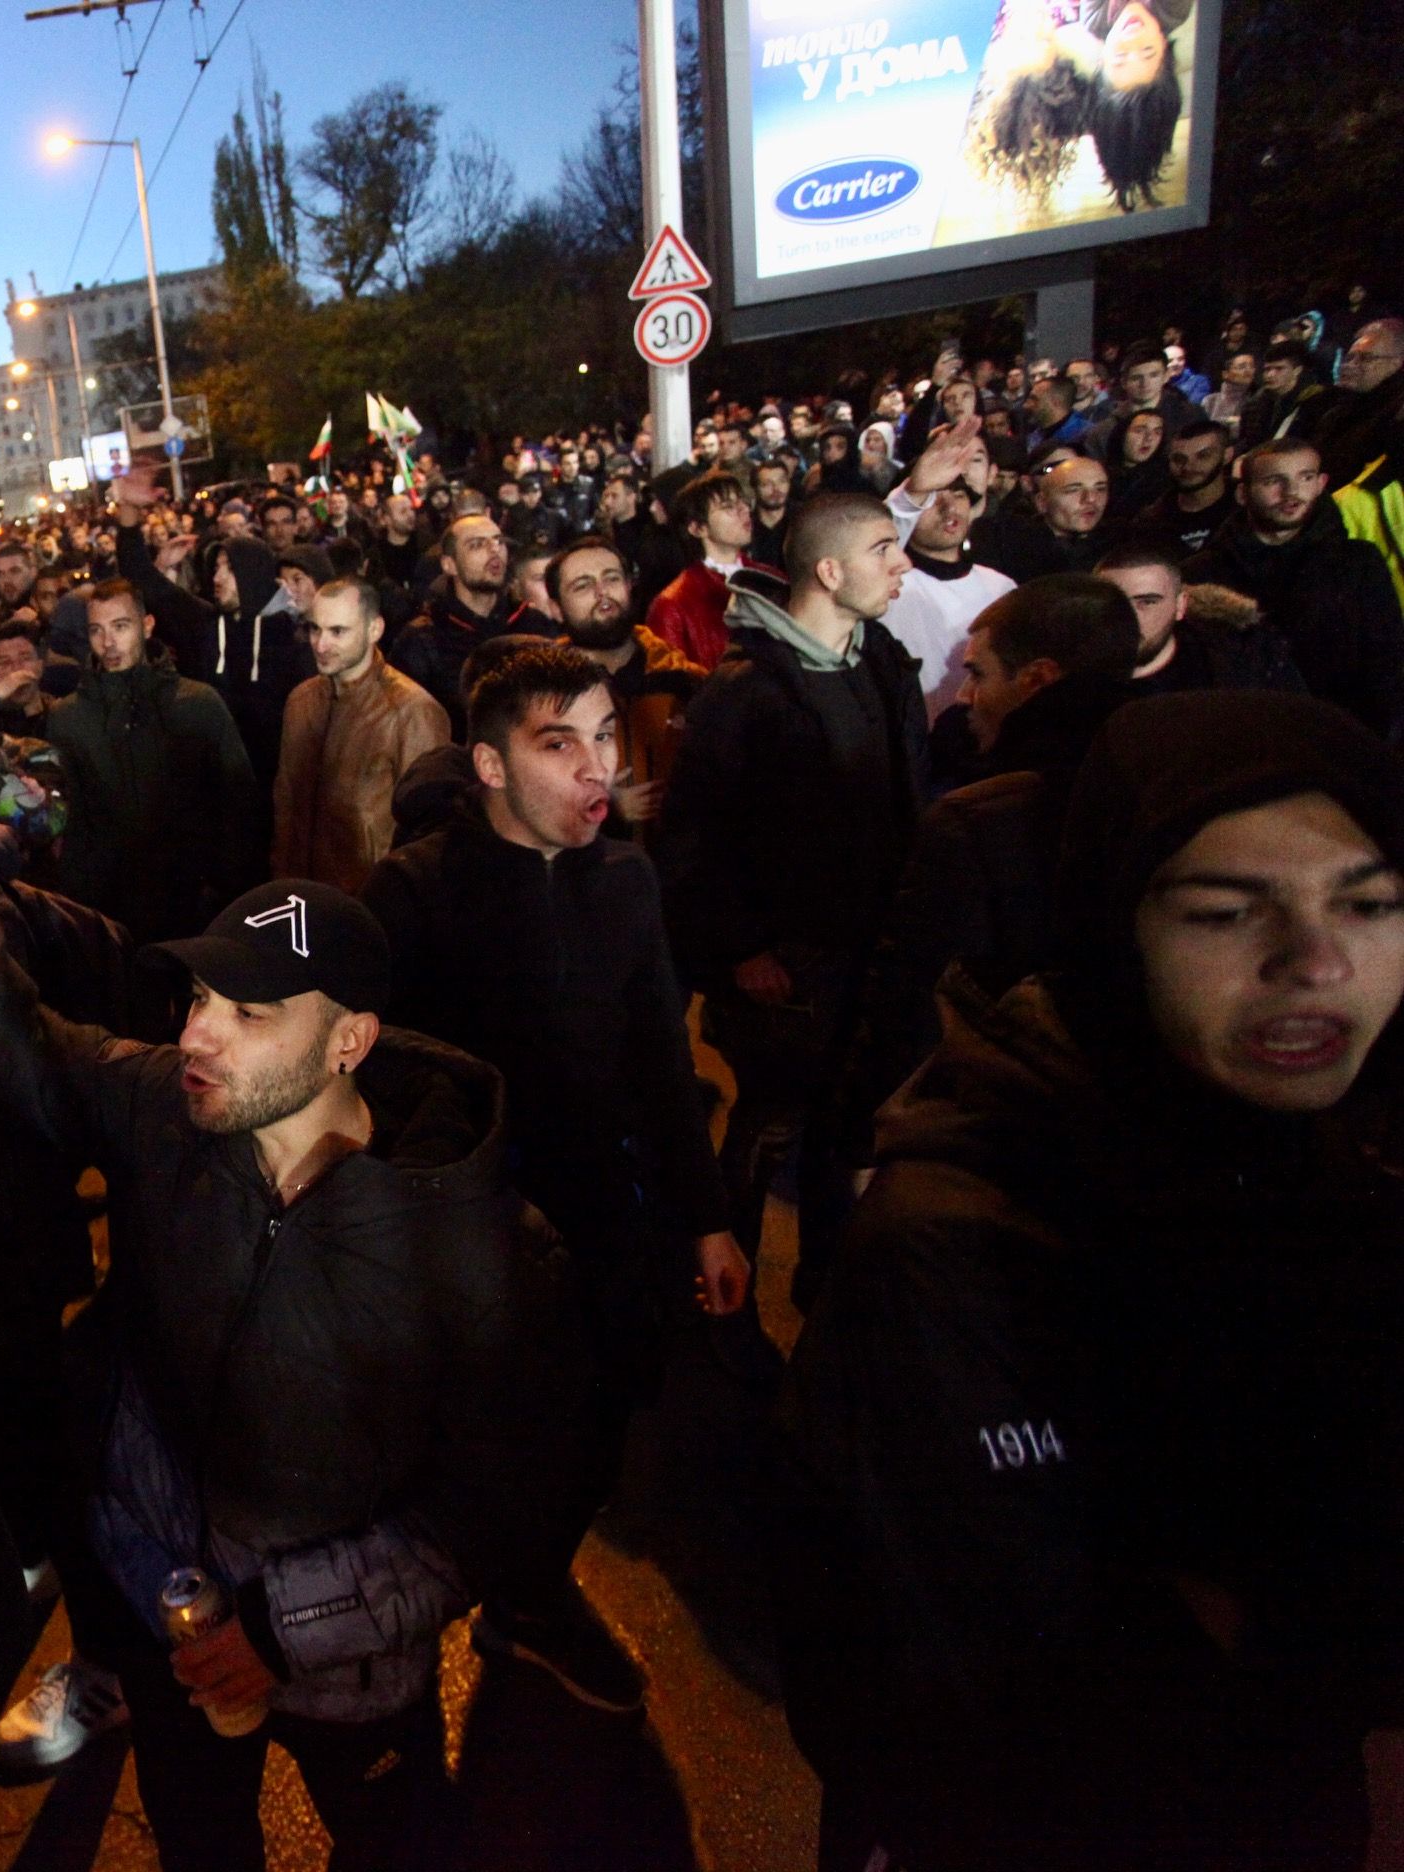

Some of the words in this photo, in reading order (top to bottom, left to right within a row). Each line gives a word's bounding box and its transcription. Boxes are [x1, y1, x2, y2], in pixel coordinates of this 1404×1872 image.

[836, 36, 967, 103] ДОМА
[793, 170, 904, 211] Carrier
[776, 243, 811, 259] Turn
[815, 240, 831, 254] to
[834, 234, 859, 250] the
[863, 223, 922, 246] experts
[652, 311, 692, 349] 30
[979, 1419, 1066, 1470] 1914
